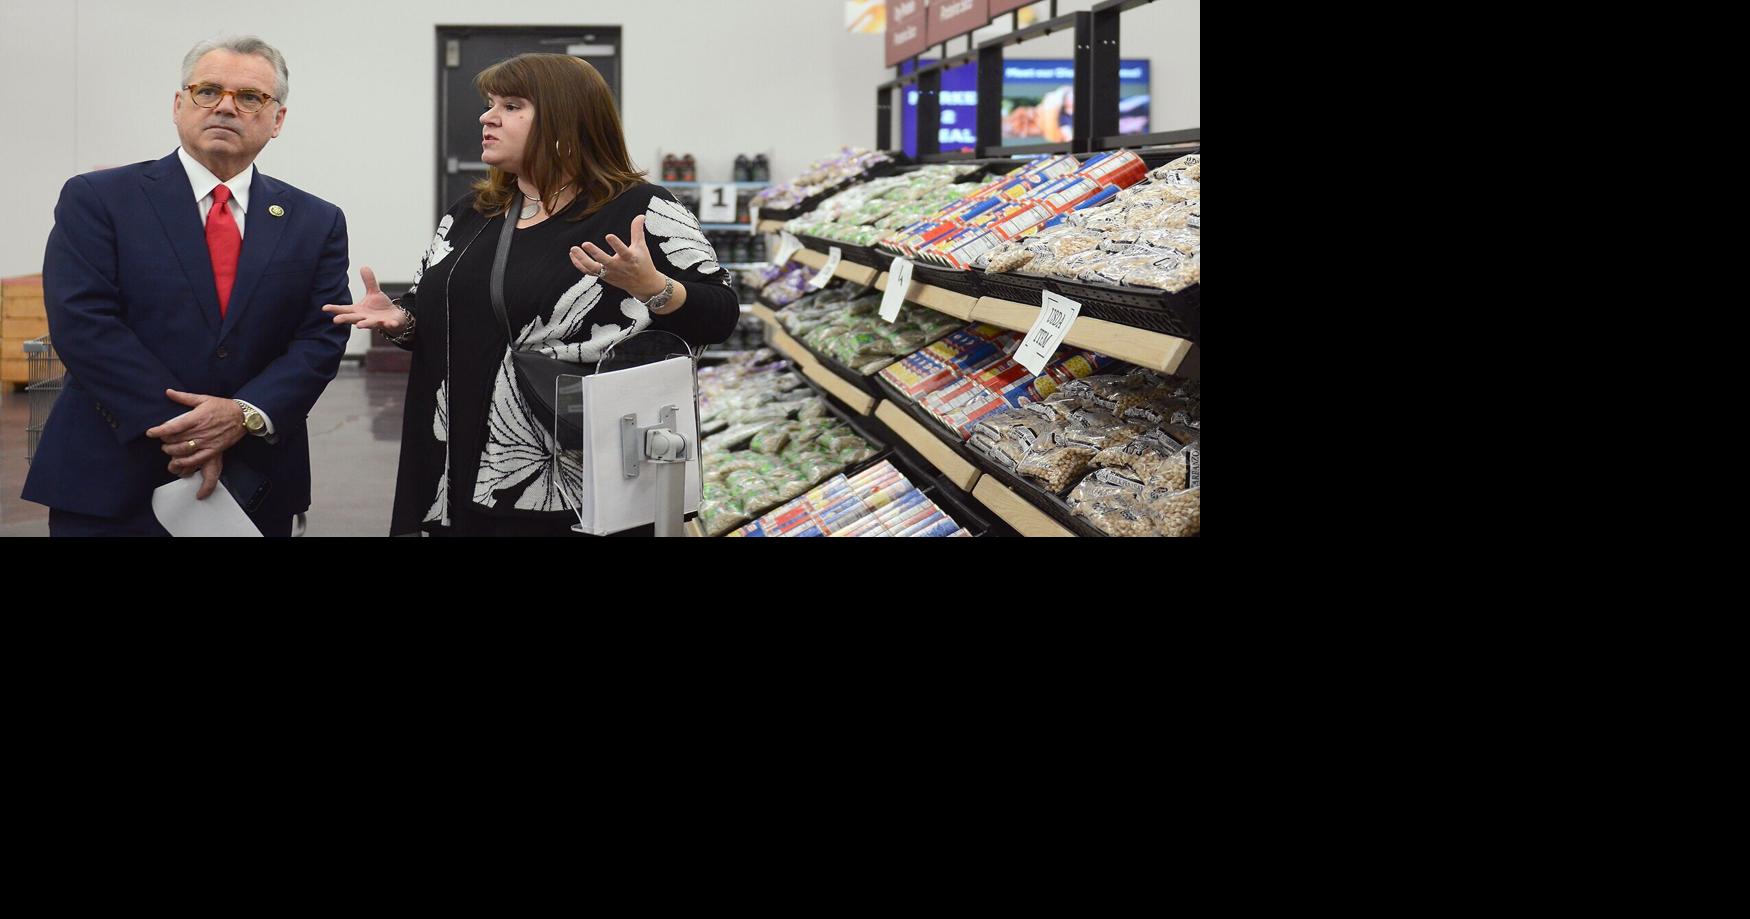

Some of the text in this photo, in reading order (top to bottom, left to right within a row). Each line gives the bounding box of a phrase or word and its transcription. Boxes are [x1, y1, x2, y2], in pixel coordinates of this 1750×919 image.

[938, 128, 977, 144] EAL
[712, 187, 728, 207] 1
[1046, 307, 1066, 329] USDA
[1033, 328, 1053, 348] ITEM
